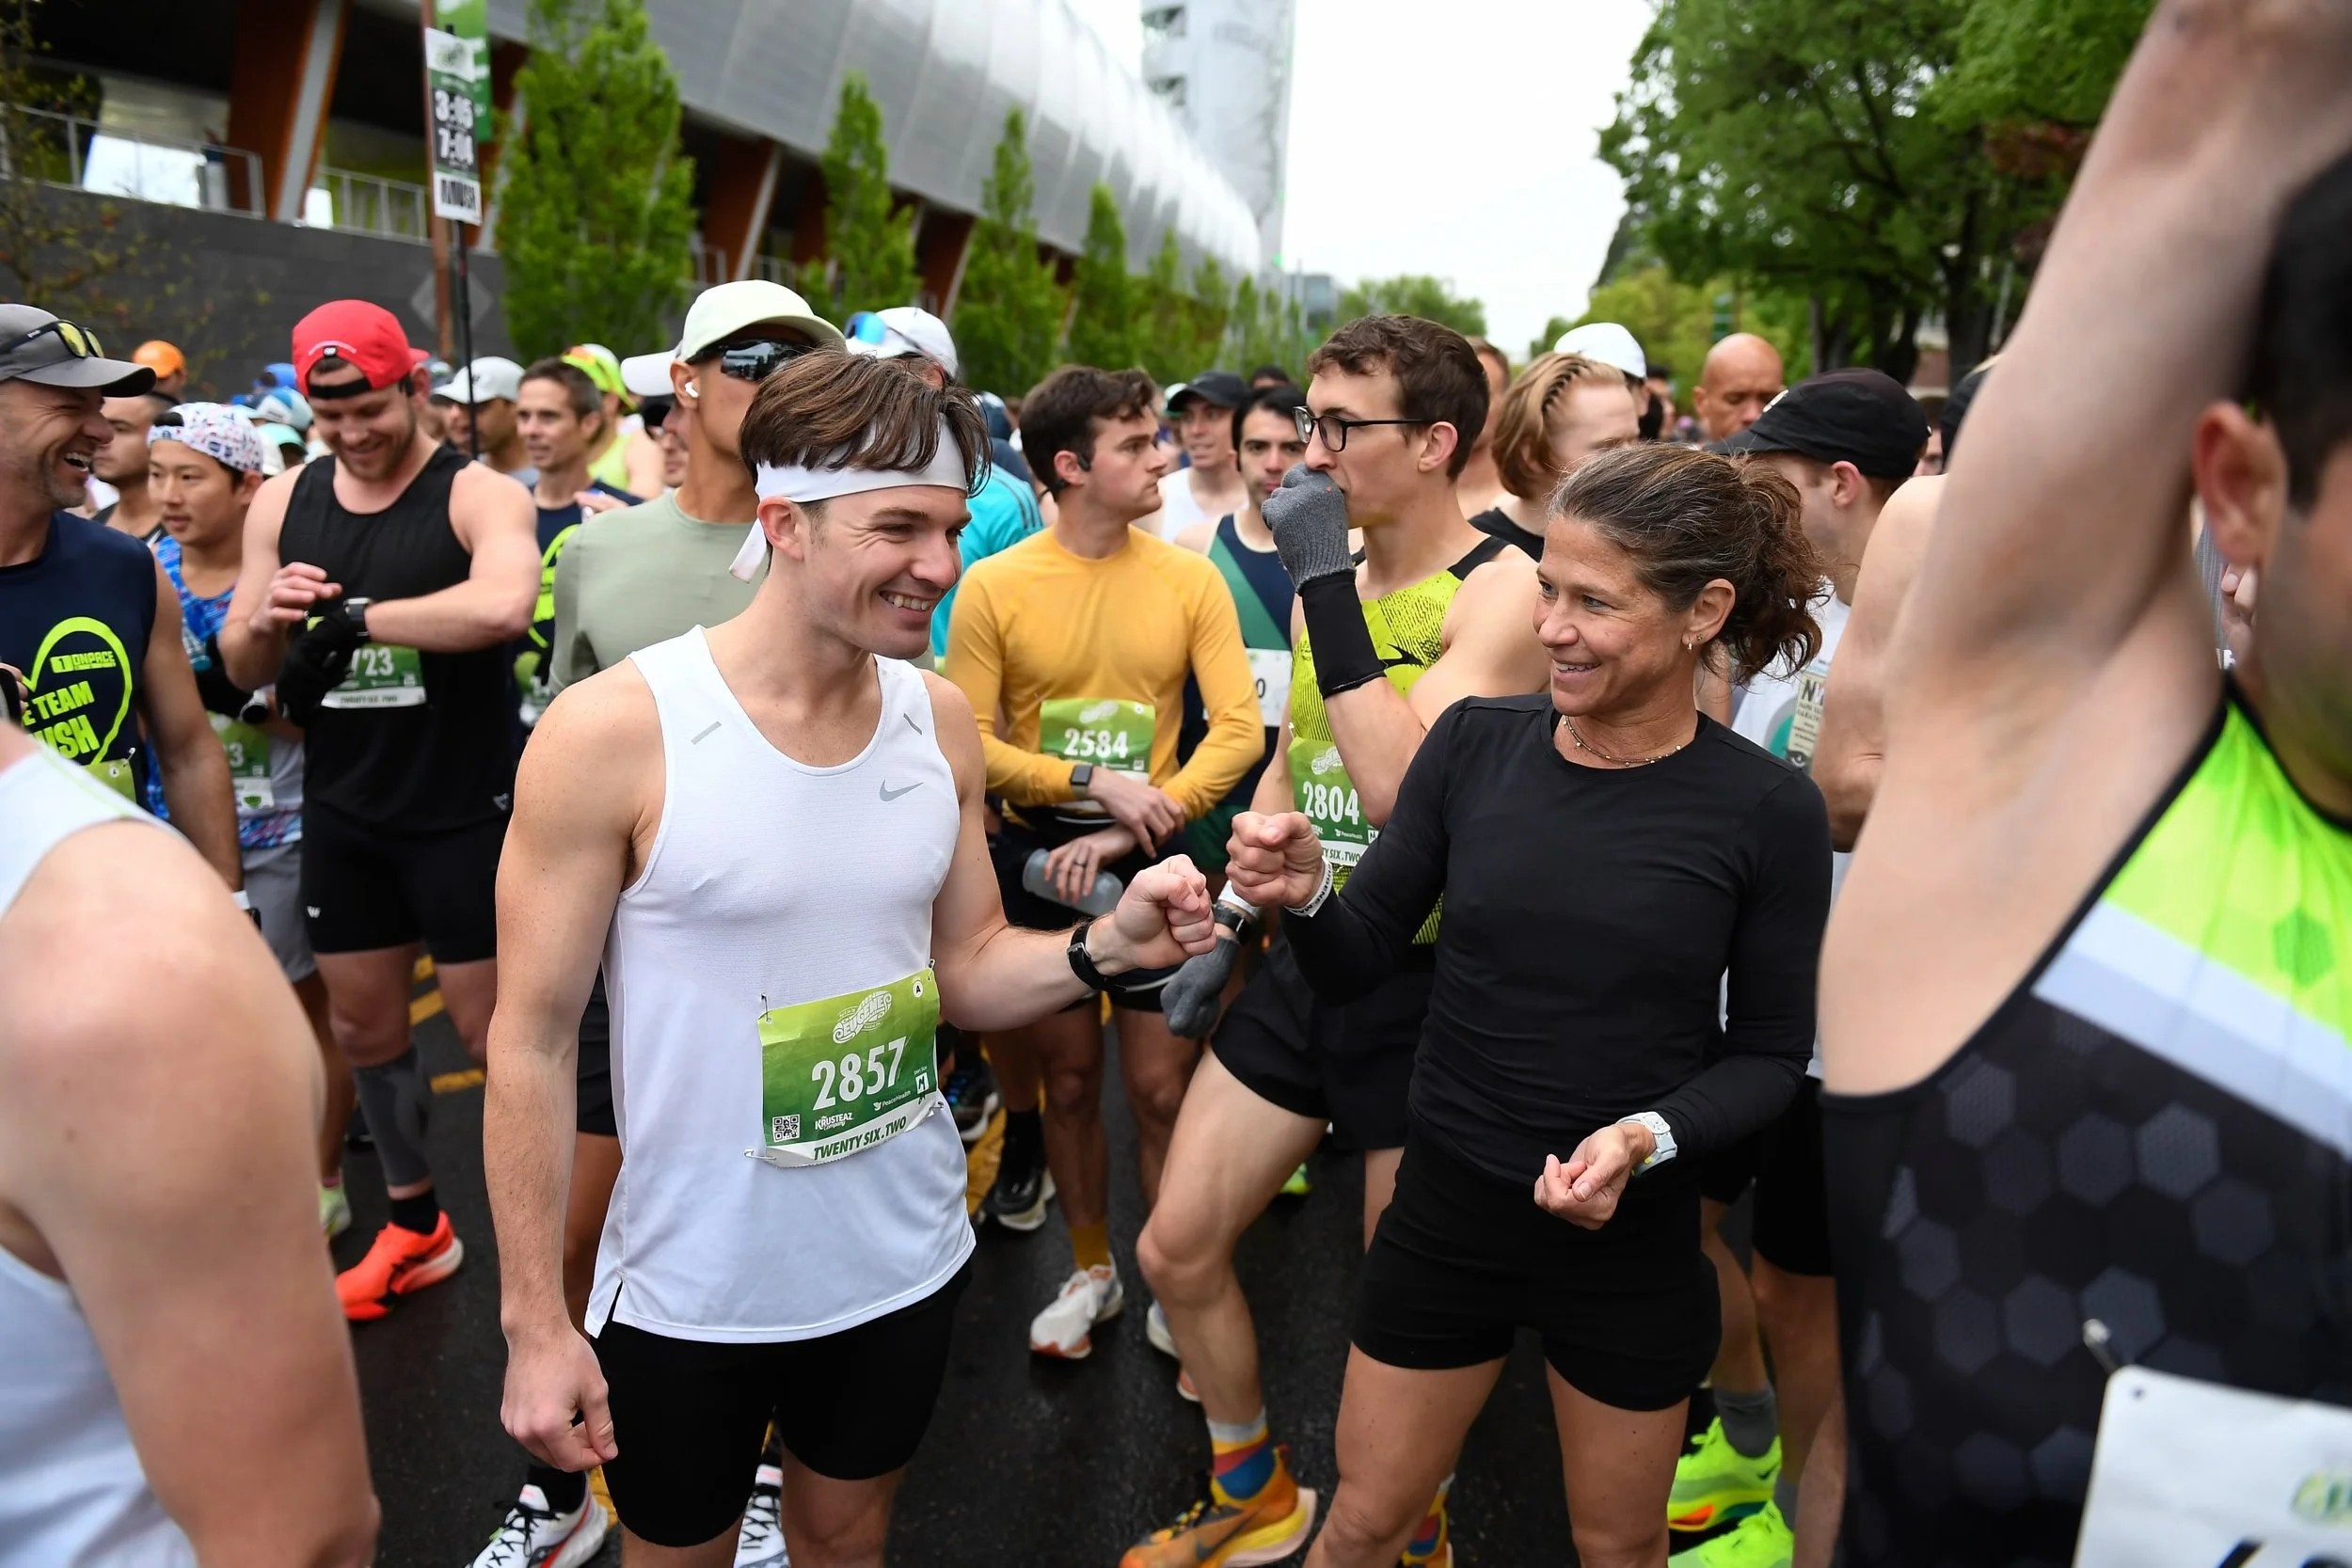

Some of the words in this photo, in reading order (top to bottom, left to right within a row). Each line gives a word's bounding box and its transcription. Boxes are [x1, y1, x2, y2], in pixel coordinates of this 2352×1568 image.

[32, 680, 95, 720] TEAM
[1063, 727, 1128, 759] 2584
[1303, 781, 1359, 826] 2804
[842, 994, 885, 1037] EUGENE
[811, 1036, 907, 1111] 2857
[882, 1090, 911, 1108] PeaceHealth
[815, 1112, 853, 1131] KRUSTEAZ
[814, 1134, 864, 1161] TWENTY
